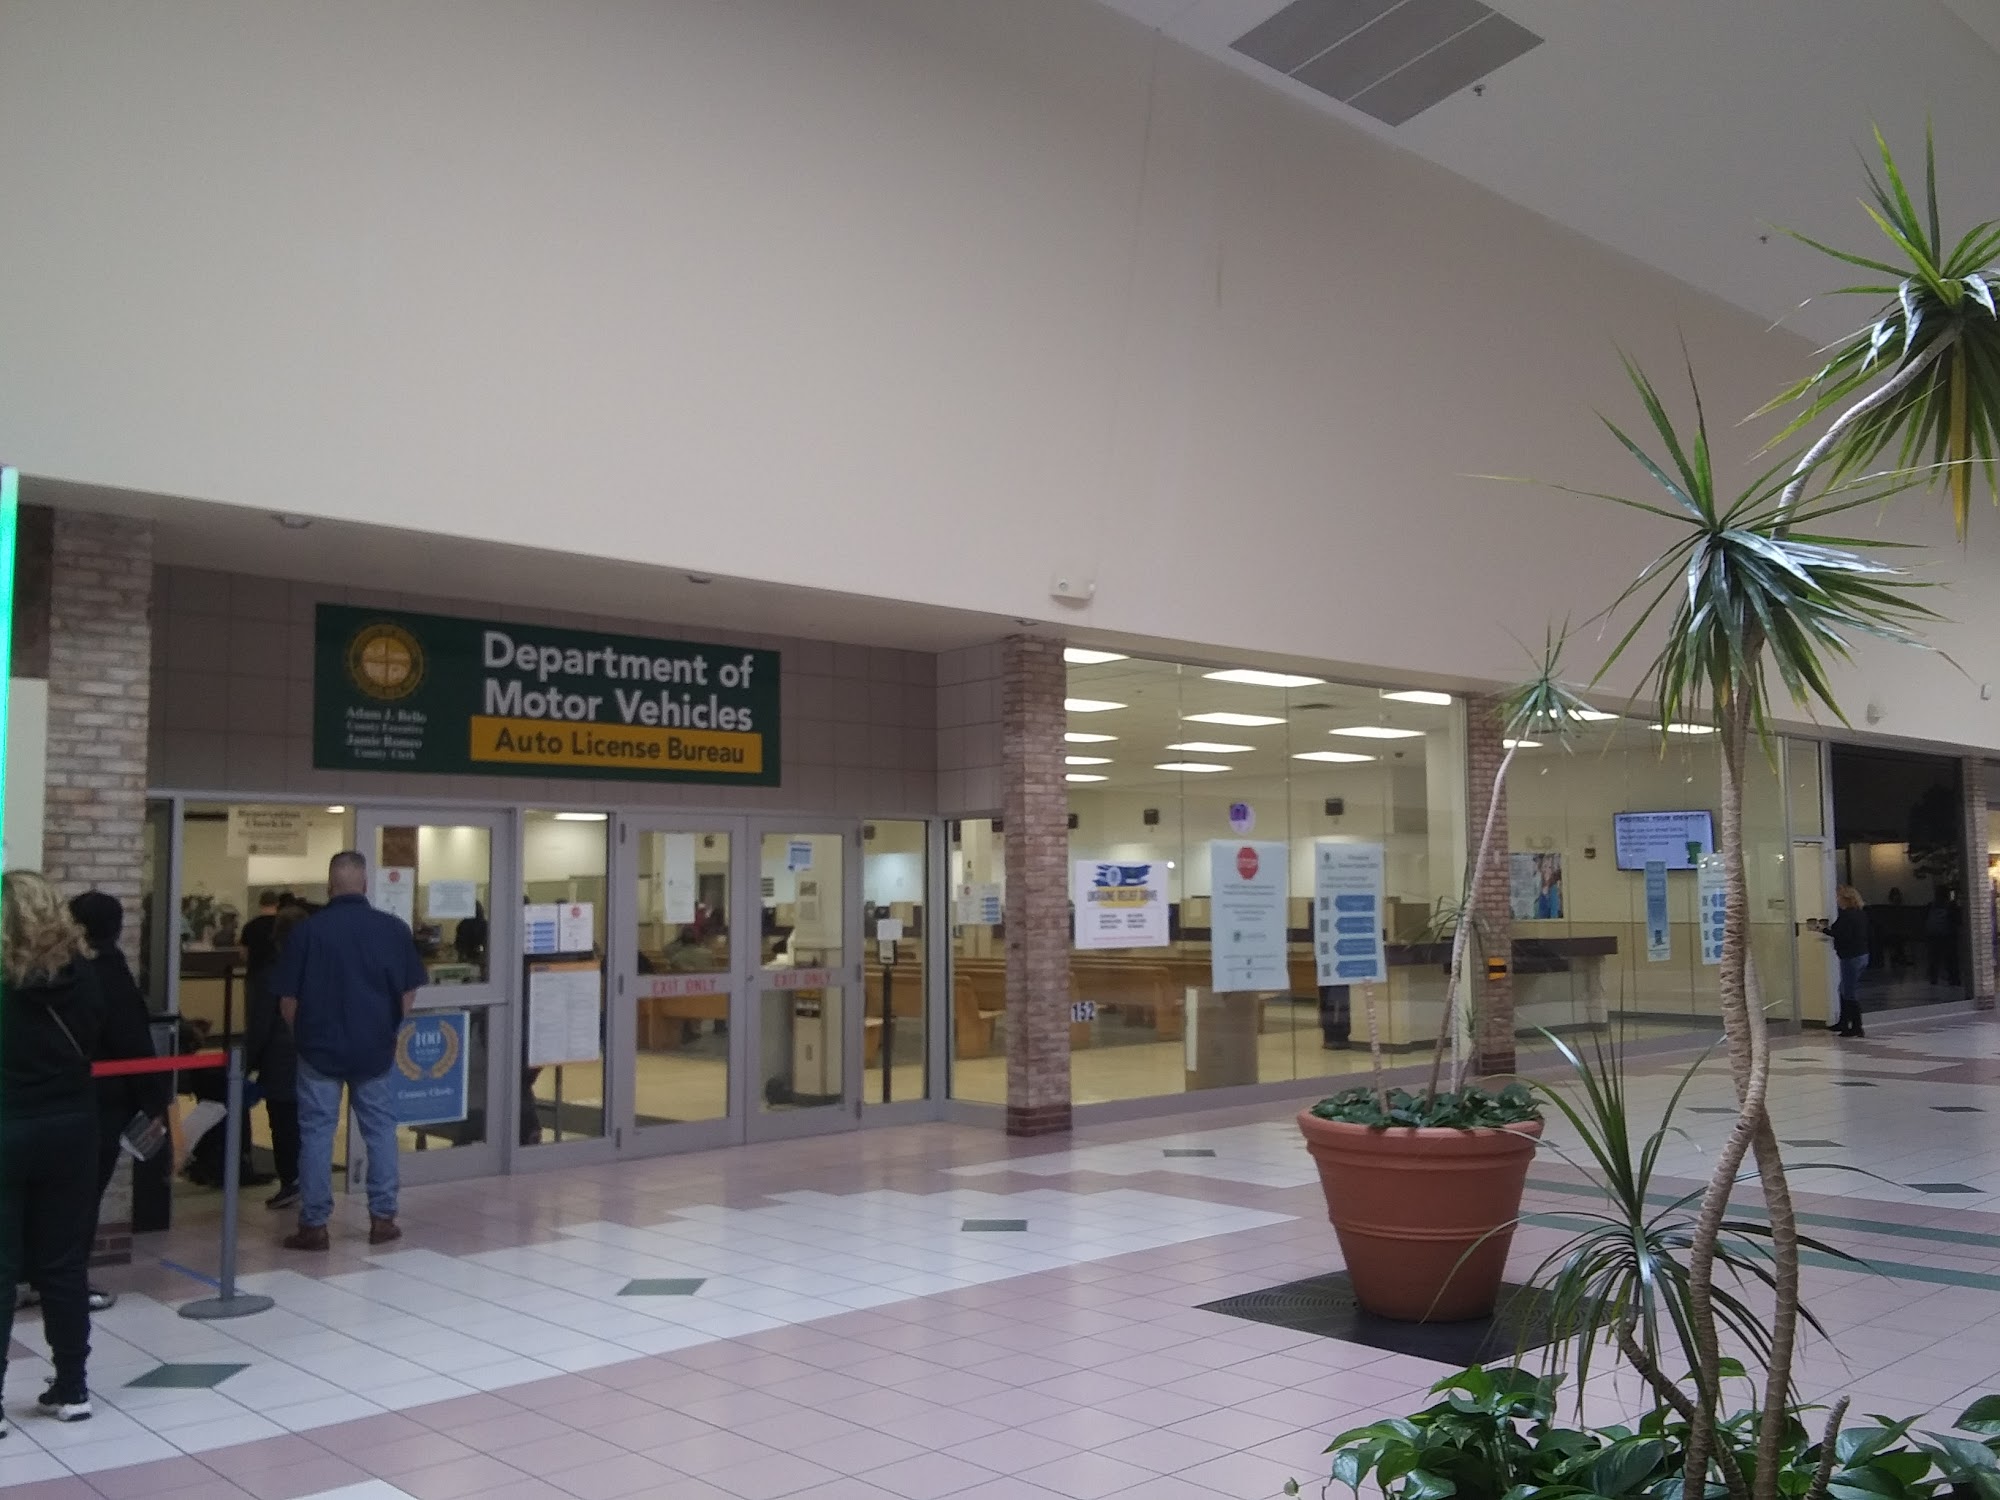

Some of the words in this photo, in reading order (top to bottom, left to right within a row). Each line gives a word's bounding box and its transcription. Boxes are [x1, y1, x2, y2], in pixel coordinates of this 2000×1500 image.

[484, 631, 708, 682] Department
[719, 654, 754, 689] of
[484, 677, 603, 721] Motor
[614, 688, 754, 731] Vehicles
[494, 727, 563, 754] Auto
[572, 731, 660, 759] License
[668, 736, 744, 764] Bureau
[652, 979, 678, 995] EXIT
[686, 978, 716, 993] ONLY
[774, 973, 797, 987] EXIT
[805, 971, 832, 985] ONLY
